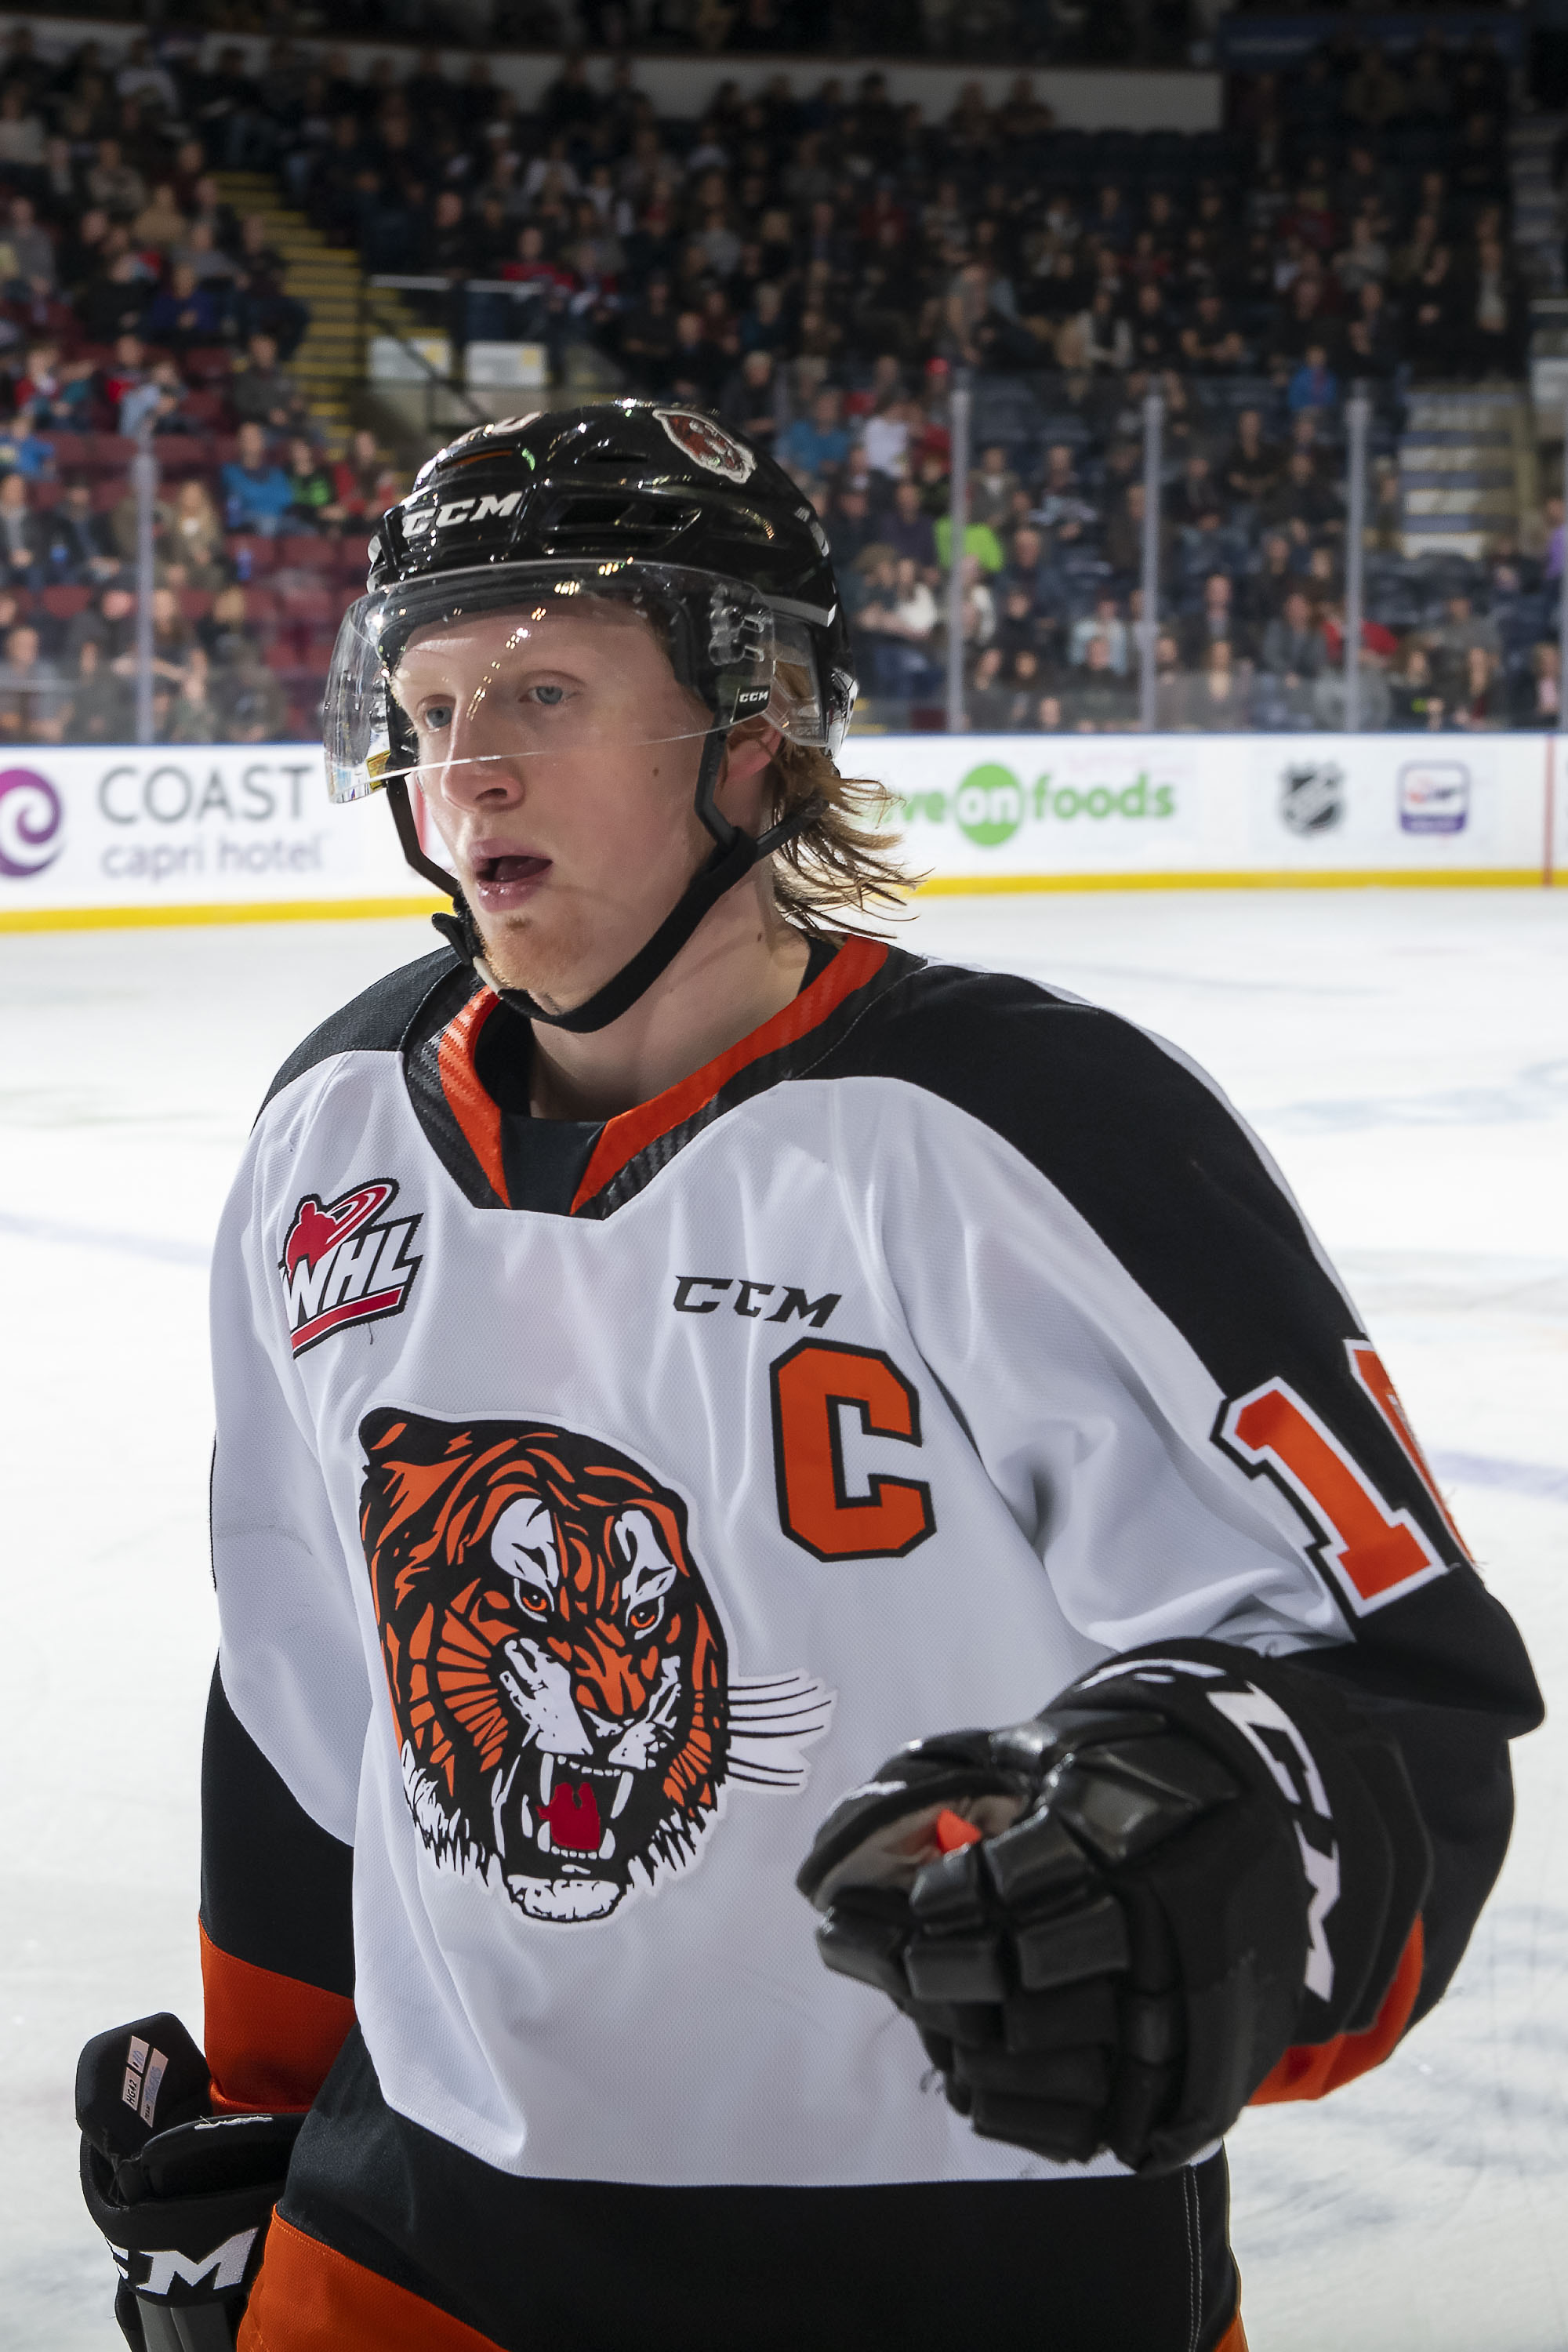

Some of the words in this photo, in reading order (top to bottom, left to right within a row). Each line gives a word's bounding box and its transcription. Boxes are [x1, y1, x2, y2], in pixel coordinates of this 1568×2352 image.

[401, 491, 523, 539] CCM
[739, 691, 769, 703] CCM
[97, 764, 314, 825] COAST
[957, 788, 1020, 826] on
[1031, 771, 1176, 820] foods
[102, 839, 205, 884] capri
[219, 831, 322, 872] hotel
[278, 1221, 412, 1331] WHL
[673, 1276, 842, 1328] CCM
[769, 1336, 937, 1563] C
[126, 2079, 137, 2105] HG42
